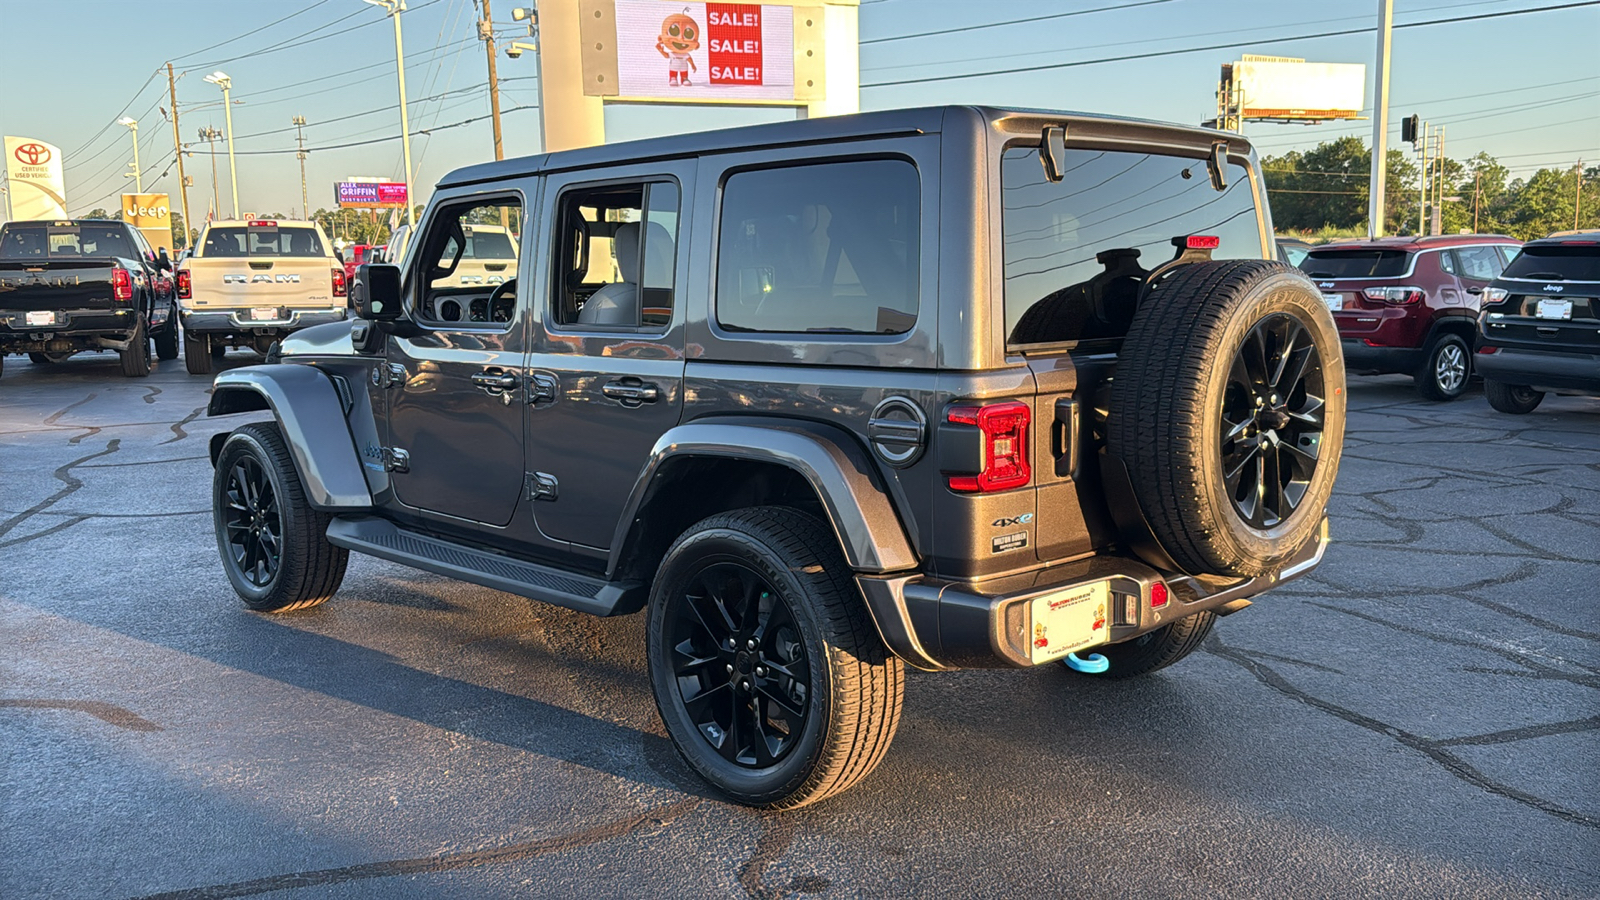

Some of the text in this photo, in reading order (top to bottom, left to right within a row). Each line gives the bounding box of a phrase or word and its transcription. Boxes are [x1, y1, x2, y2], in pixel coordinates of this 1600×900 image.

[709, 12, 759, 27] SALE!
[710, 39, 759, 54] SALE!
[710, 66, 760, 81] SALE!
[341, 188, 376, 196] GRIFFIN
[127, 203, 168, 220] Jeep
[223, 274, 301, 284] RAM
[1543, 284, 1565, 293] Jeep
[991, 513, 1034, 527] 4xe
